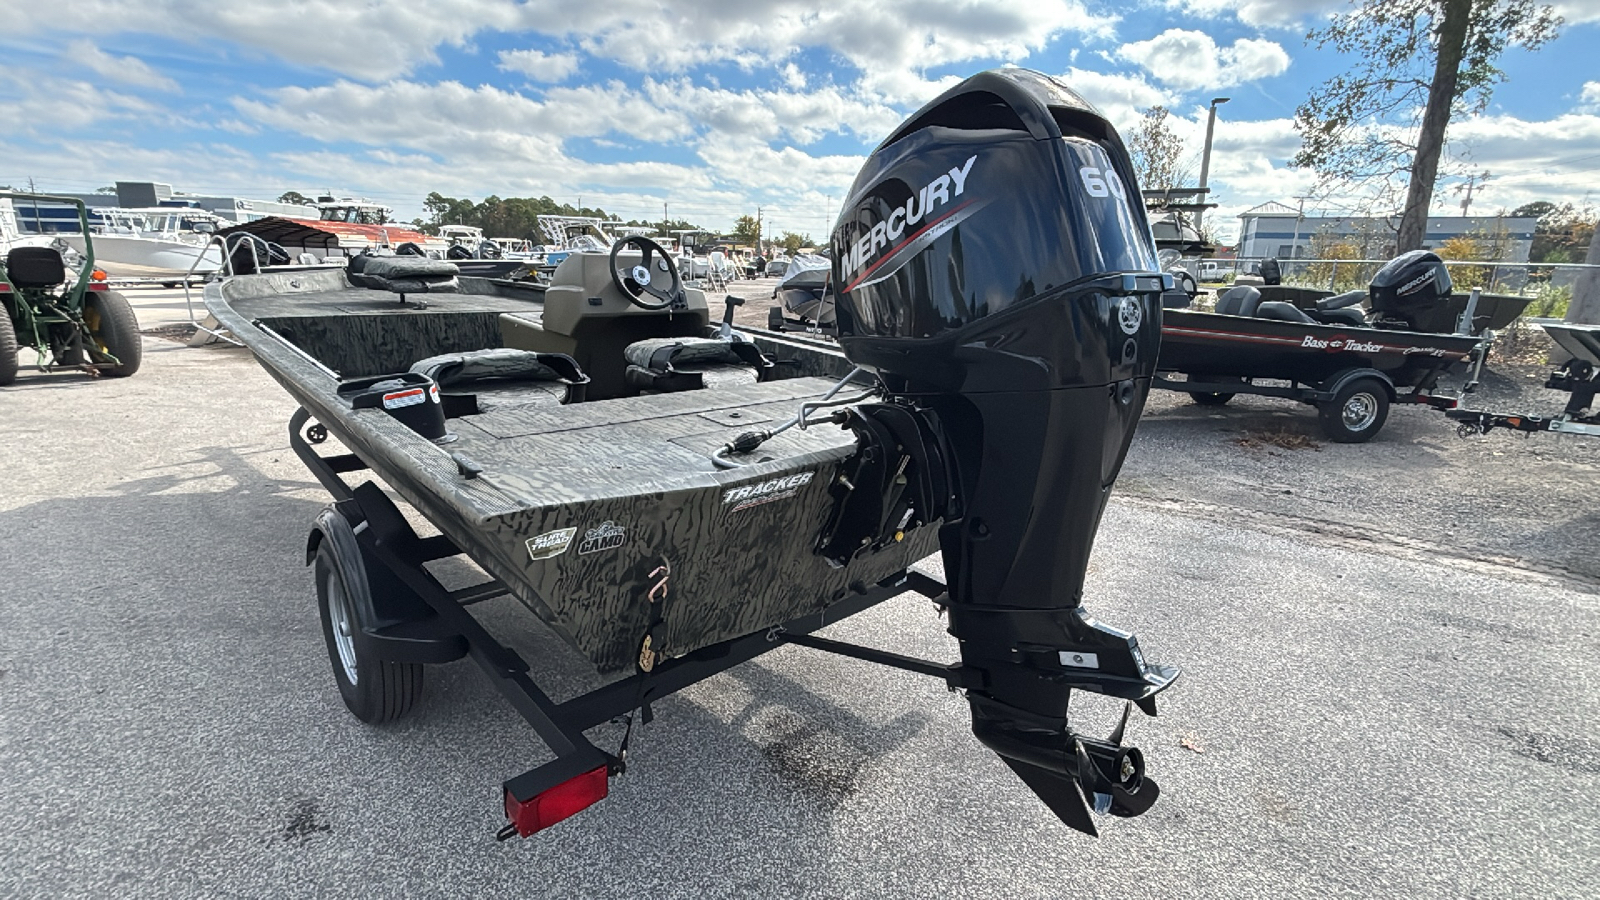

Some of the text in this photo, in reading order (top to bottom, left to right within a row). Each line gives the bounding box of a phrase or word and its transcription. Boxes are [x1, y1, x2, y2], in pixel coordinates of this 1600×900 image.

[1079, 166, 1127, 201] 60
[841, 154, 978, 283] MERCURY
[1396, 266, 1437, 296] MERCURY
[805, 326, 823, 334] NITO
[1300, 334, 1385, 354] Bass Tracker
[722, 471, 815, 504] TRACKER
[581, 534, 624, 553] CAMO
